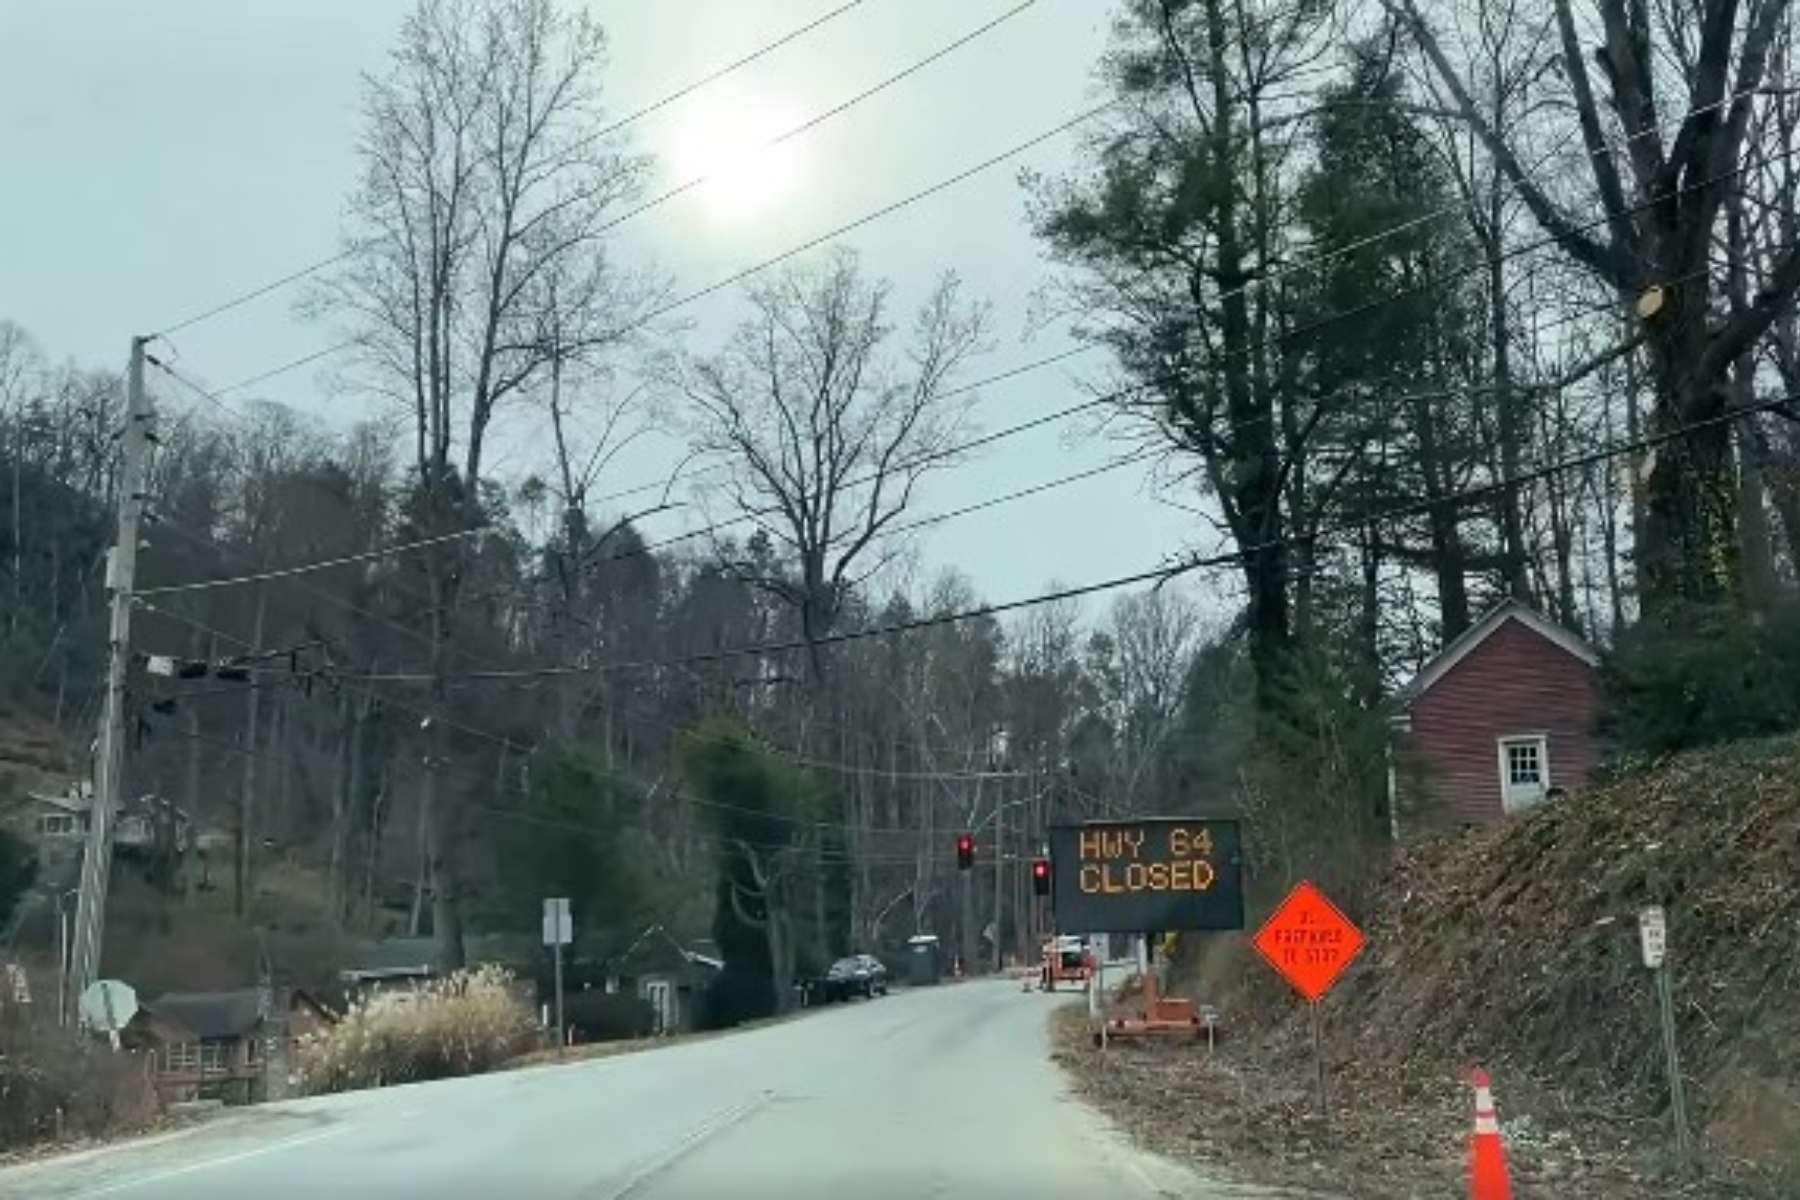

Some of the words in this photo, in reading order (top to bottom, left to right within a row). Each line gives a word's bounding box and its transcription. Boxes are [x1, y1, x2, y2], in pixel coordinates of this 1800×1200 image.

[1079, 830, 1145, 859] HWY
[1170, 828, 1213, 856] 64
[1079, 860, 1214, 893] CLOSED
